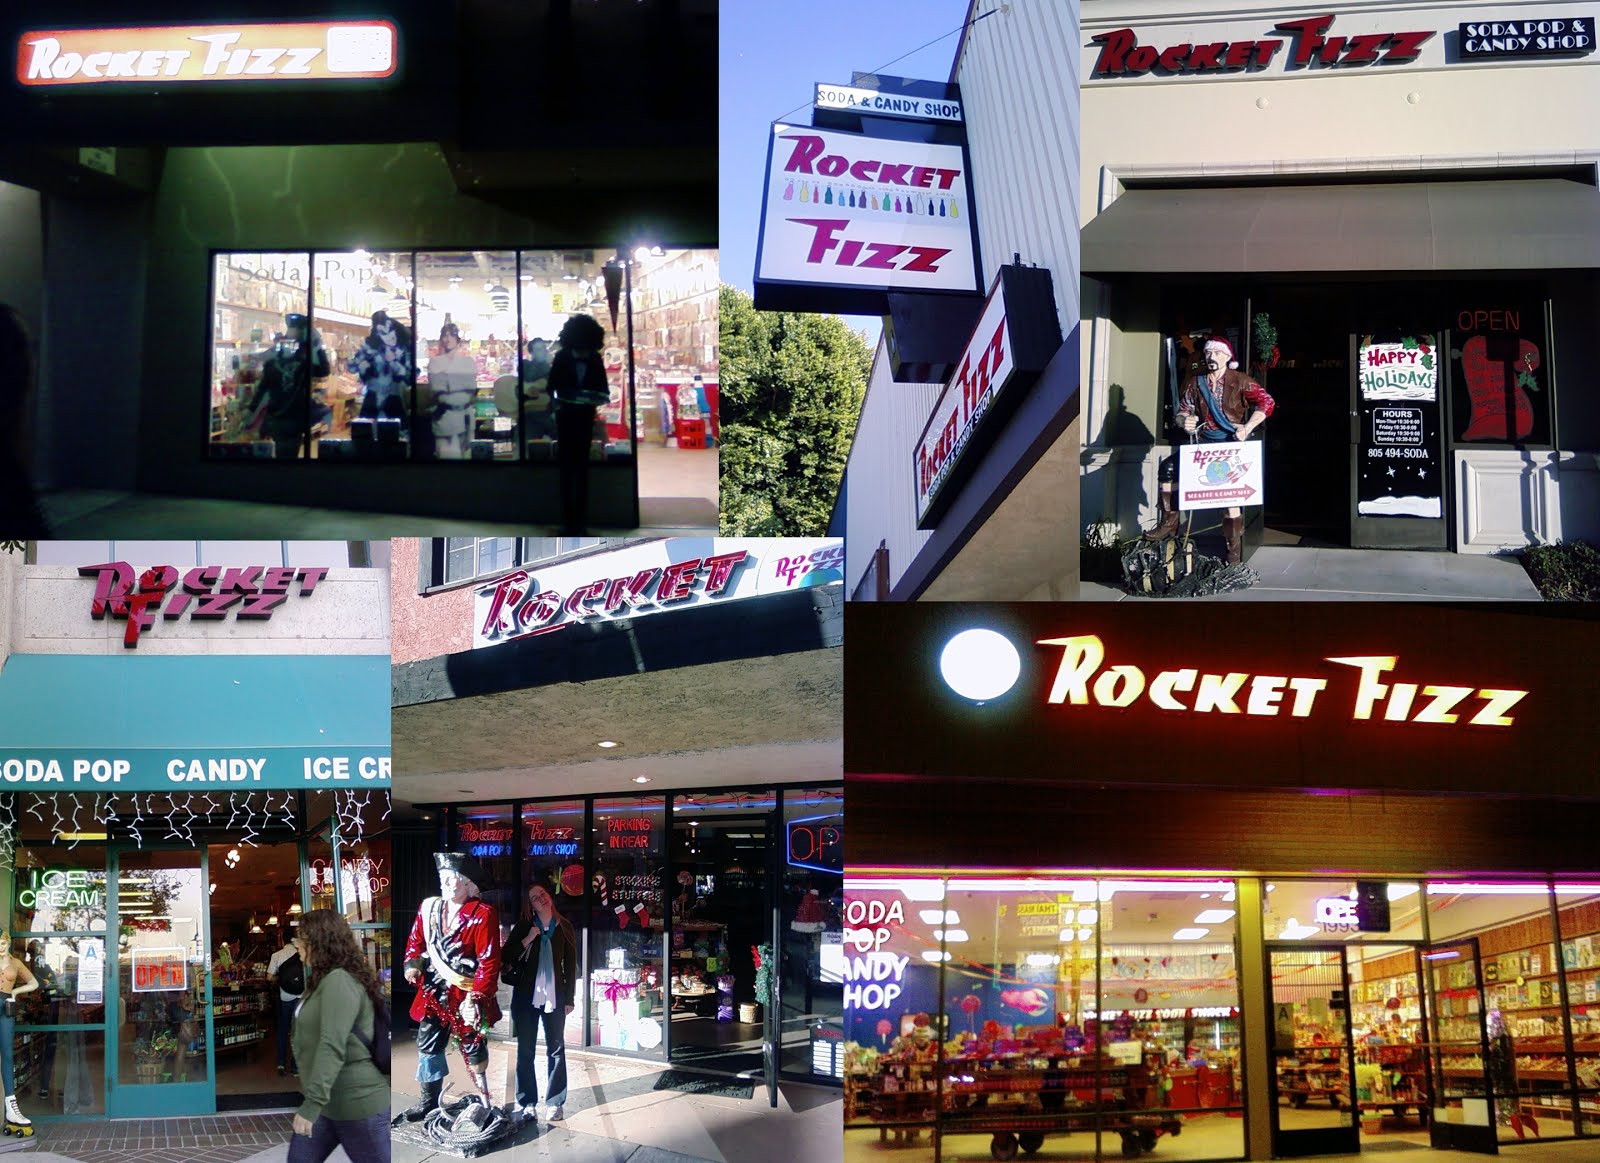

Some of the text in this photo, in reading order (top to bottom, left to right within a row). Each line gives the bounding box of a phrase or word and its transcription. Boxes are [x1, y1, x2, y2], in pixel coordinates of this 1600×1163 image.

[1466, 19, 1586, 37] SODA POP &
[1090, 14, 1437, 76] ROCKET FIZZ
[1465, 34, 1590, 52] CANDY SHOP
[26, 37, 191, 80] ROCKET
[187, 32, 324, 76] FIZZ
[817, 90, 961, 119] SODA & CANDY SHOP
[778, 135, 962, 190] ROCKET
[784, 217, 953, 273] FIZZ
[238, 259, 374, 285] Soda Pop
[1457, 310, 1520, 331] OPEN
[1367, 348, 1418, 366] HAPPY
[917, 315, 1006, 501] ROCKET FIZZ
[1382, 410, 1413, 418] HOURS
[955, 419, 975, 456] CANDY
[974, 388, 992, 424] SHOP
[1190, 448, 1241, 464] ROCKET
[1199, 456, 1232, 469] FIZZ
[1368, 448, 1429, 459] 805 494-SODA
[77, 560, 330, 621] ROCKET
[473, 550, 750, 640] ROCKET
[97, 591, 289, 649] FIZZ
[1036, 634, 1530, 727] ROCKET FIZZ
[0, 759, 64, 782] ODA
[73, 759, 131, 782] POP
[166, 758, 267, 782] CANDY
[303, 757, 350, 780] ICE
[459, 819, 574, 842] ROCKET FIZZ
[607, 817, 651, 832] PARKING
[471, 844, 488, 856] ODA
[488, 844, 503, 856] POP
[554, 843, 578, 855] SHOP
[609, 835, 649, 848] IN REAR
[32, 870, 88, 889] ICE
[19, 889, 99, 908] CREAM
[612, 889, 662, 902] STUFFERS
[1315, 898, 1359, 924] OPE
[85, 944, 97, 961] A
[135, 963, 184, 988] OPEN
